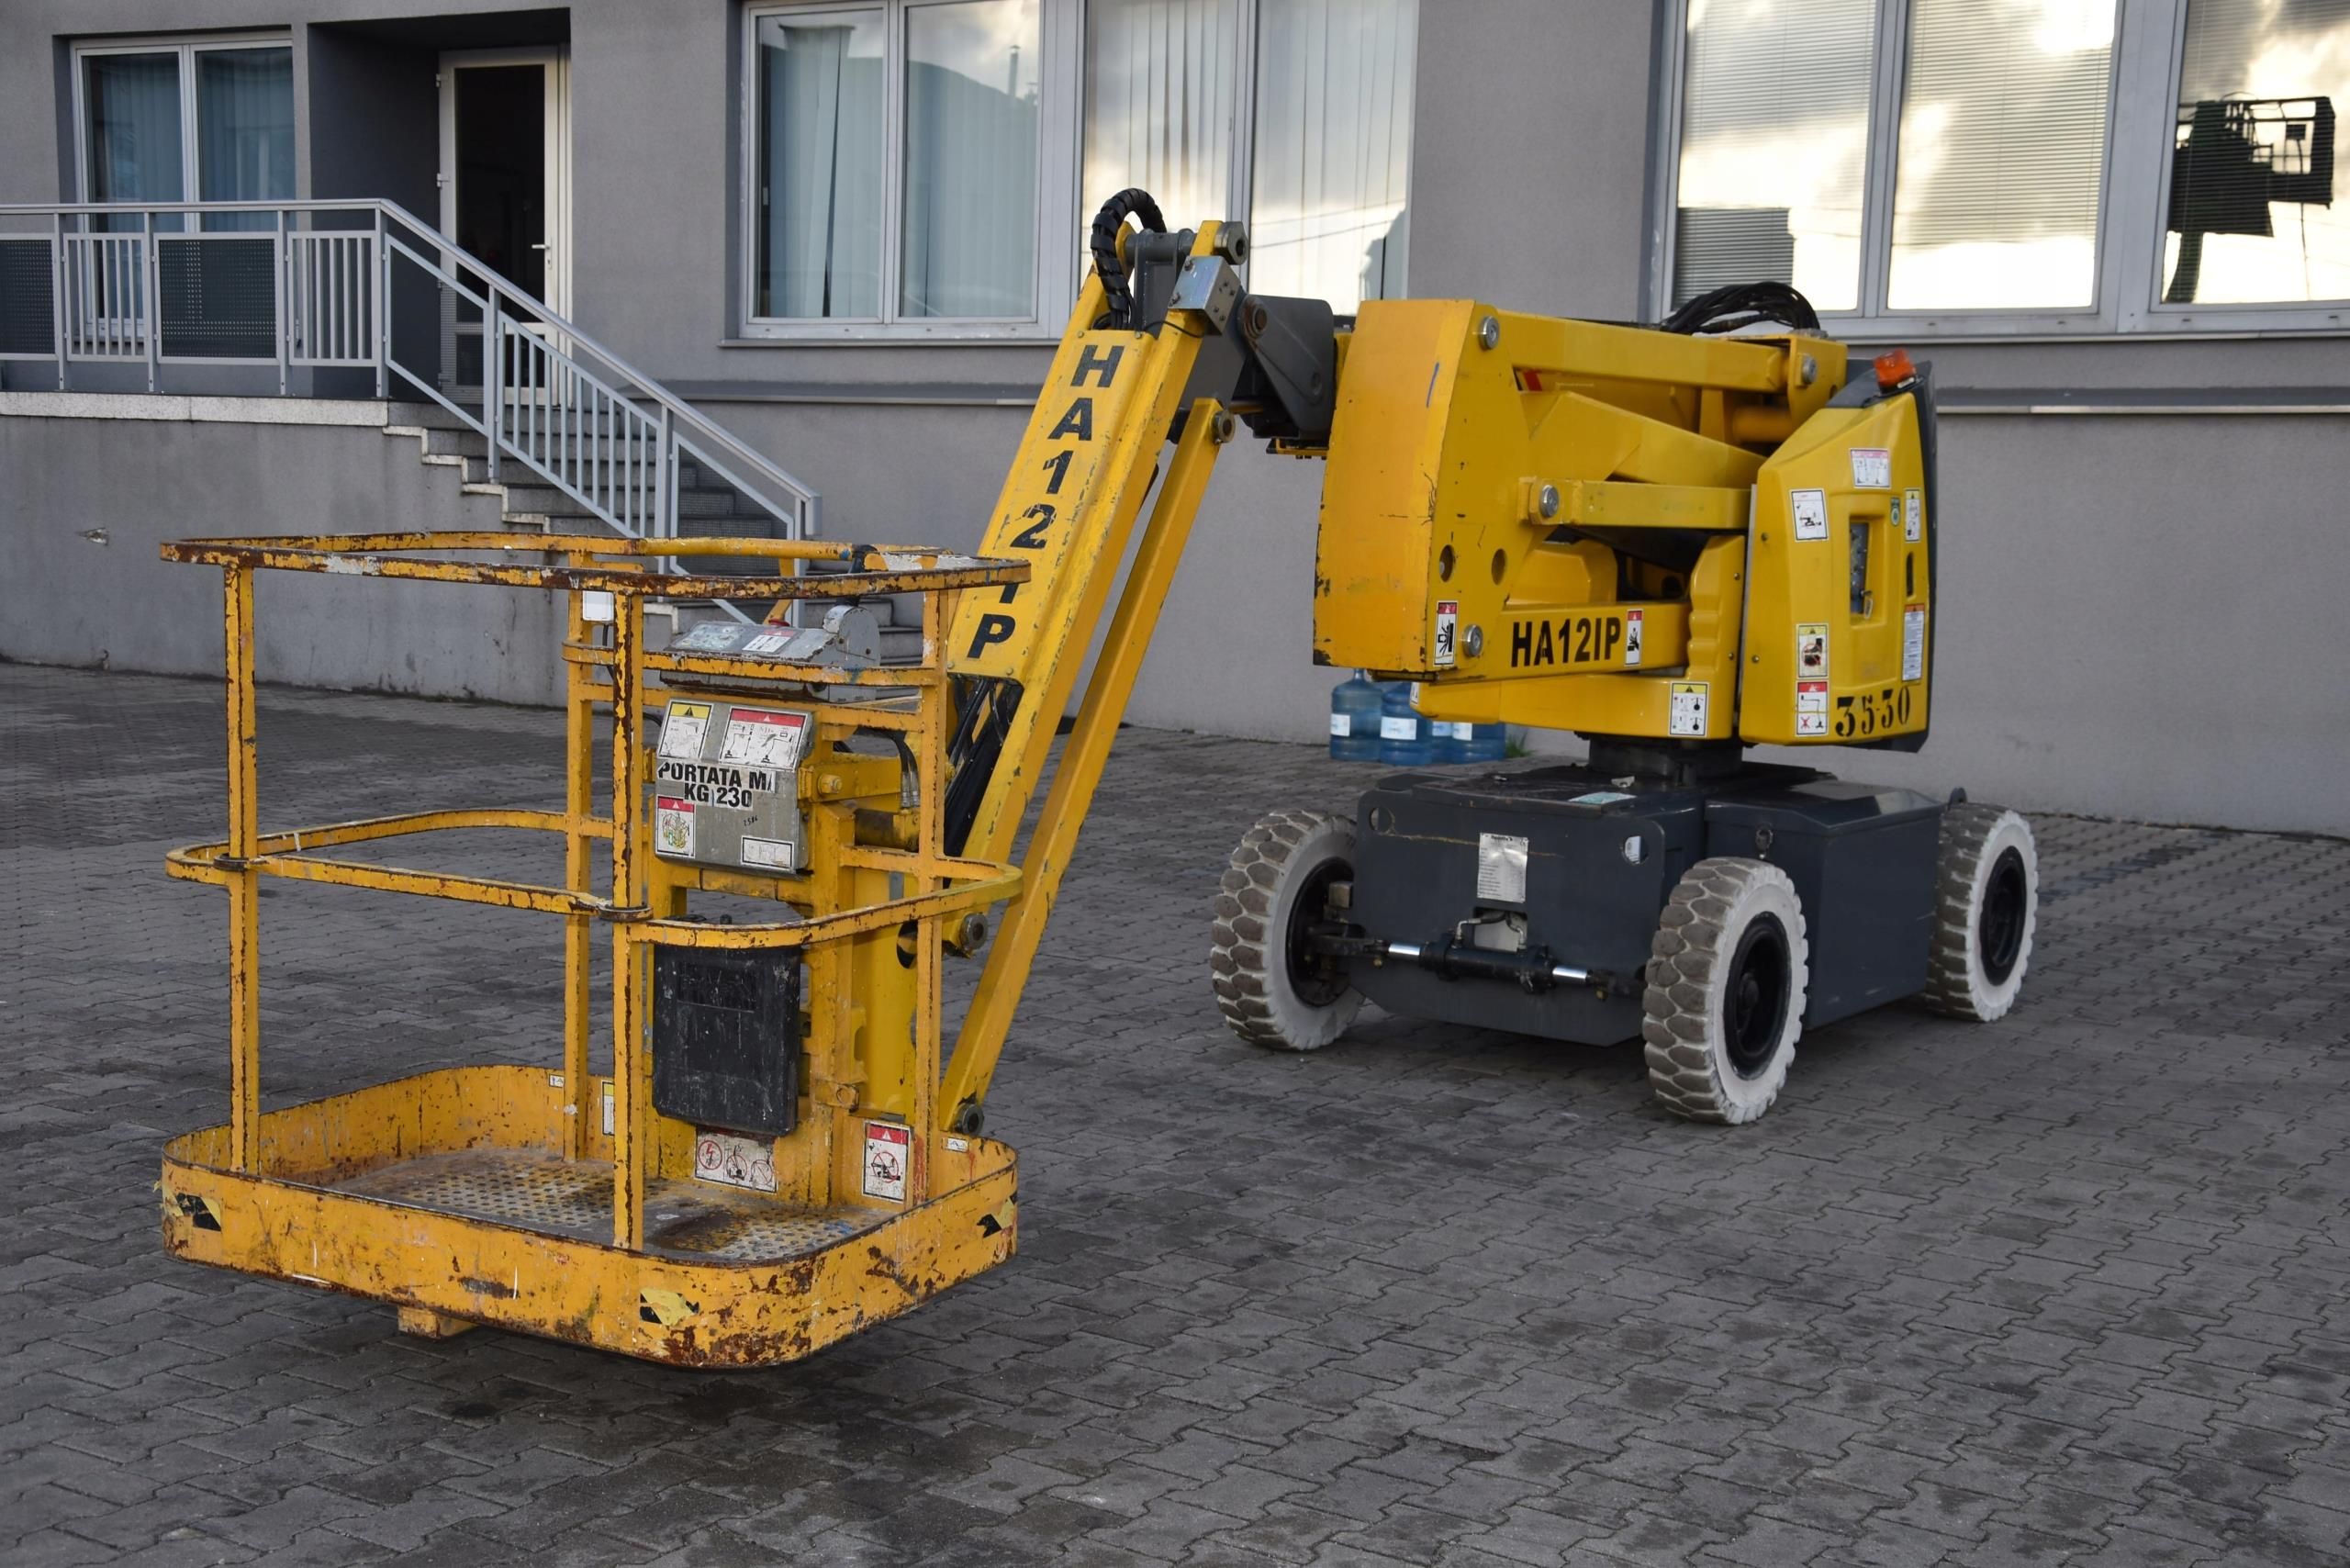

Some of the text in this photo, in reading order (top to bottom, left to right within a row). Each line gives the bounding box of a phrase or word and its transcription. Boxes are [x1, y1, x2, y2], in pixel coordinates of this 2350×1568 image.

[1511, 617, 1621, 667] HA12IP
[657, 761, 743, 788] PORTATA
[684, 783, 753, 808] KG 230
